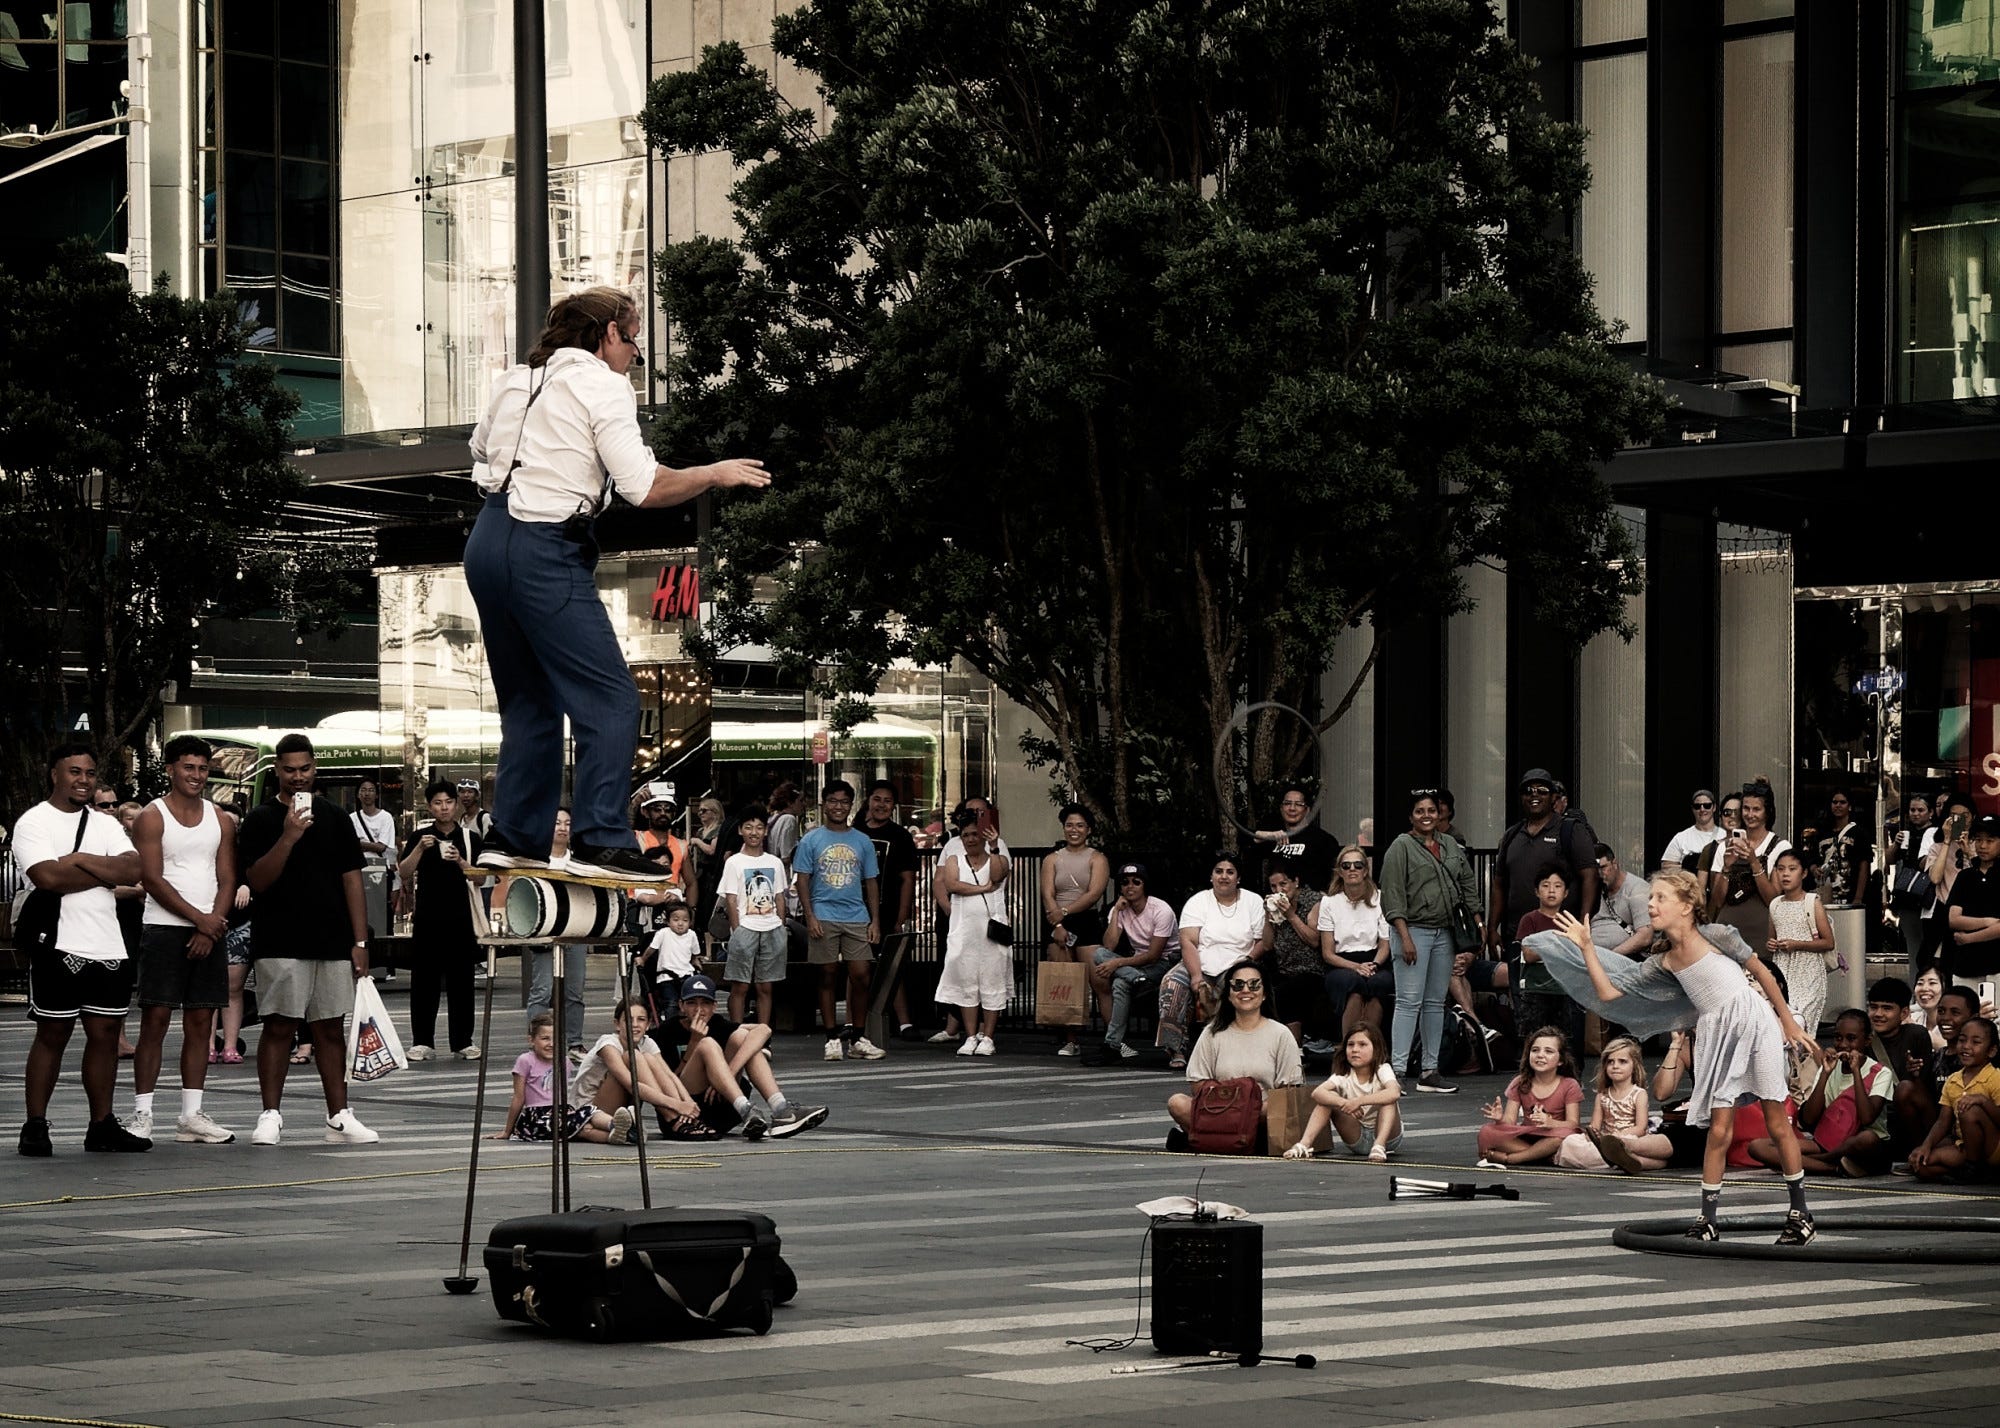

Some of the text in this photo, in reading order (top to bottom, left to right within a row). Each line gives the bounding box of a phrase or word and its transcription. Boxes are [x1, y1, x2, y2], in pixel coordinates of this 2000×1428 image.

[651, 564, 700, 621] H&M
[719, 743, 750, 752] Museum
[757, 742, 782, 751] Parnell
[886, 740, 901, 750] Park
[334, 748, 352, 758] Park
[361, 748, 379, 757] Thre
[384, 749, 403, 757] Lam
